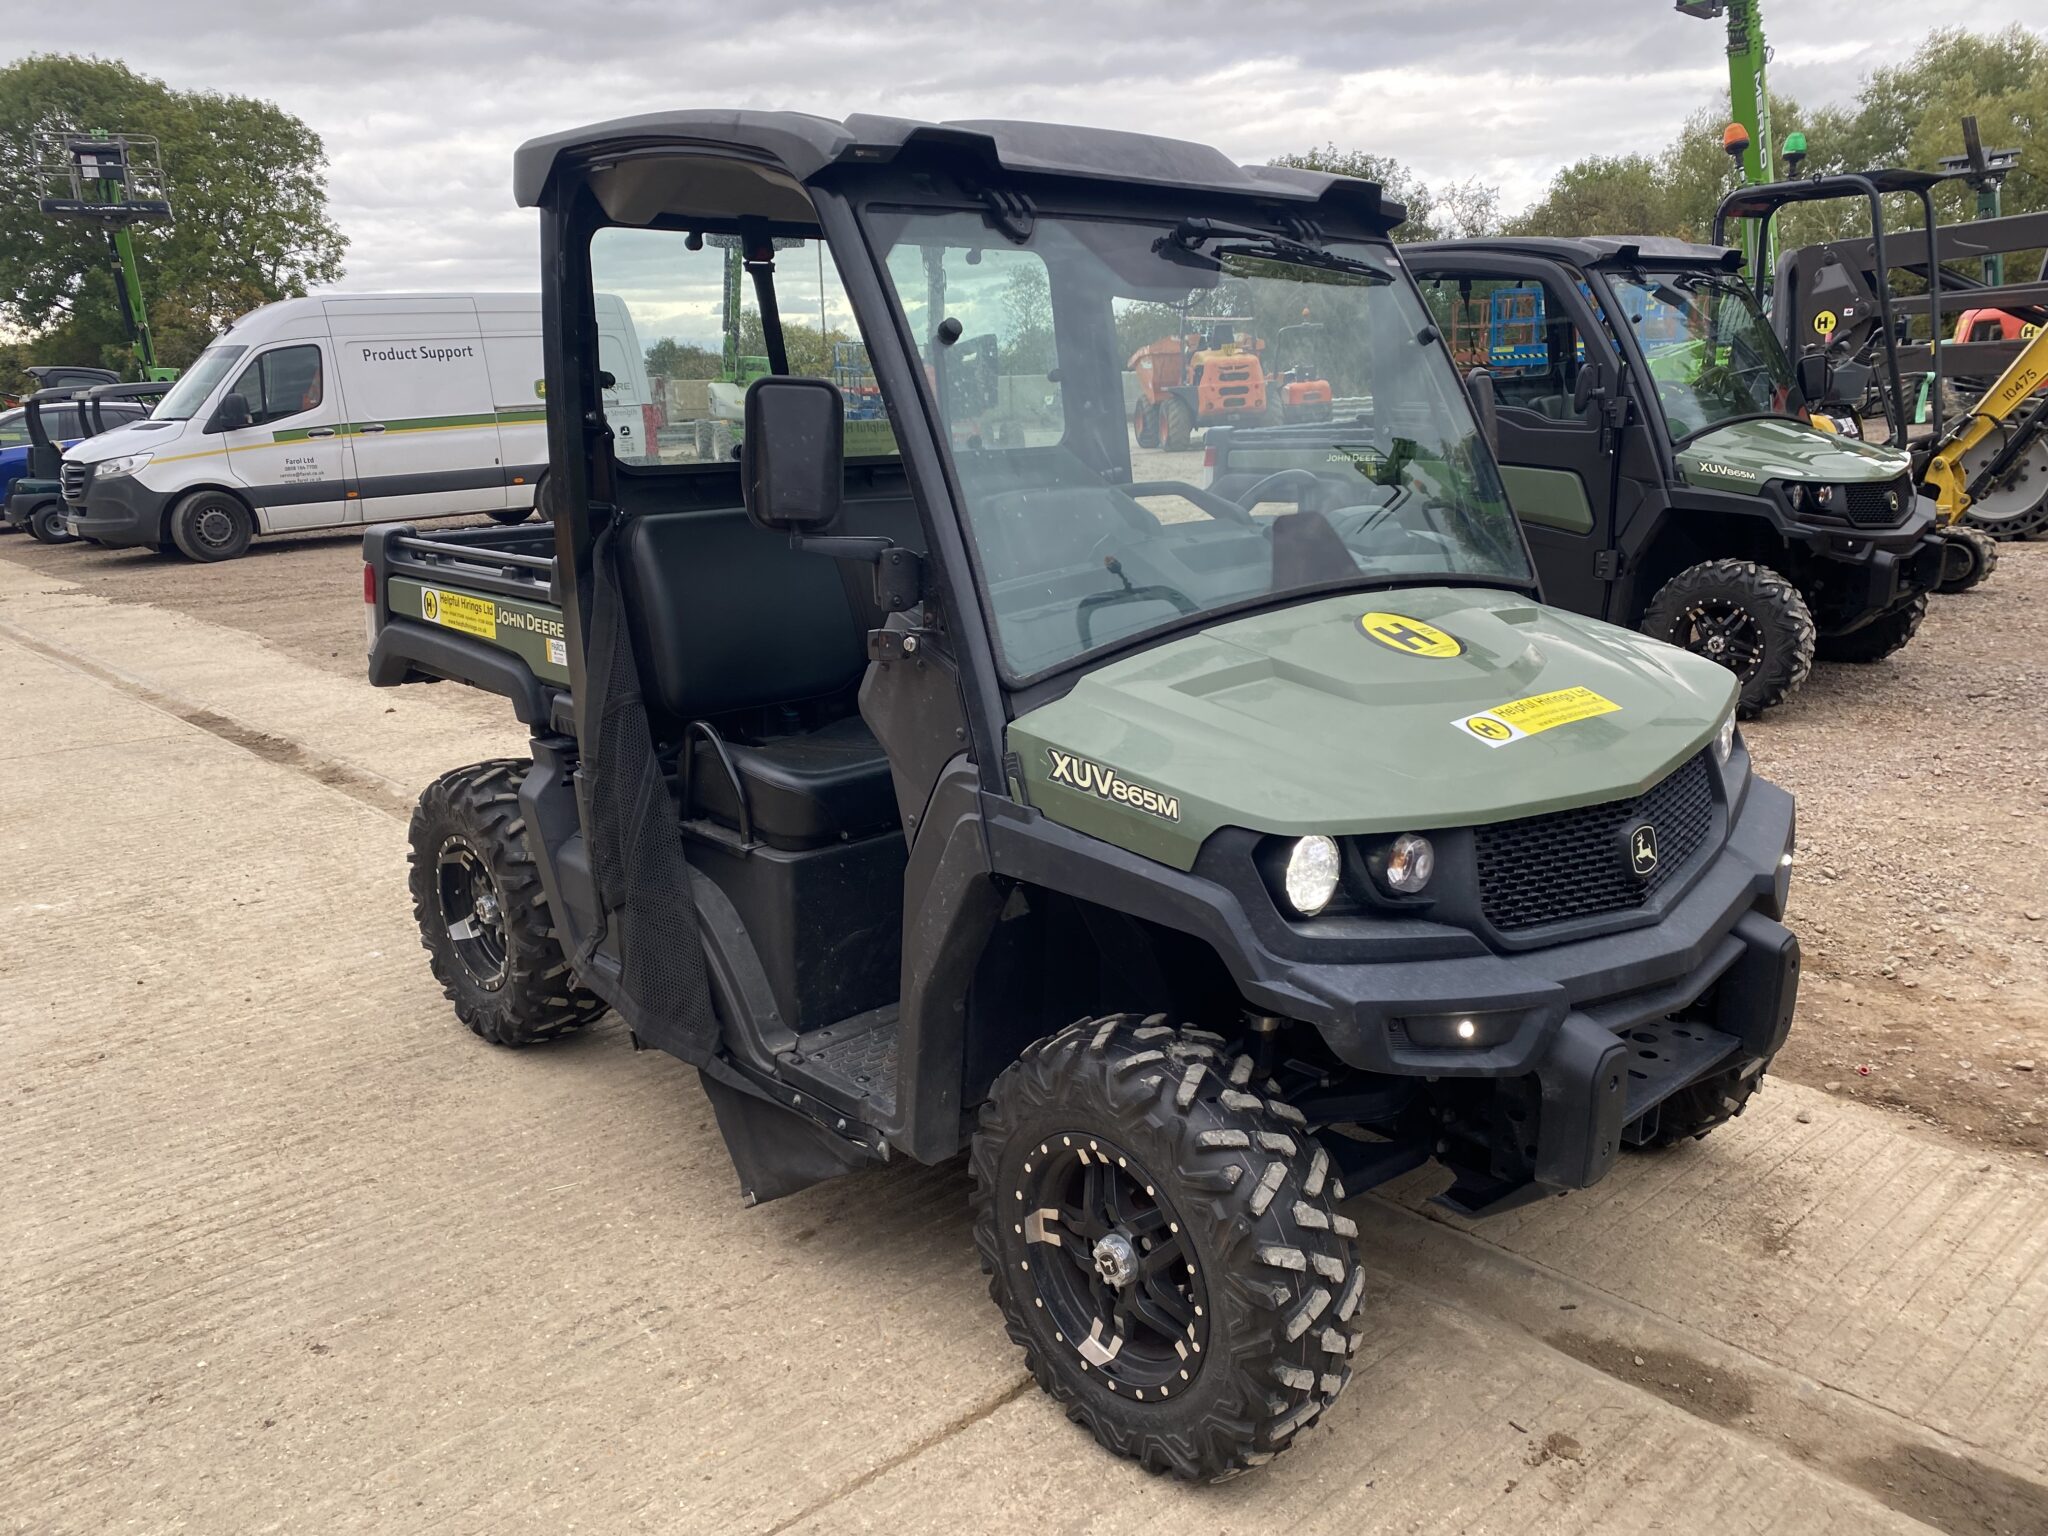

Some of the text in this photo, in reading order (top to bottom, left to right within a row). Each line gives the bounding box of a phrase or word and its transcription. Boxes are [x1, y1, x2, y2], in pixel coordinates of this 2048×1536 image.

[1754, 70, 1768, 169] MERLO
[1817, 316, 1829, 330] H
[362, 346, 474, 361] Product Support
[2002, 368, 2037, 401] 10475
[285, 457, 302, 465] Farol
[1326, 453, 1351, 463] JOHN
[1698, 461, 1756, 480] XUV865M
[439, 593, 494, 616] Helpful Hirings Ltd
[496, 607, 525, 629] JOHN
[526, 612, 565, 639] DEERE
[1373, 622, 1439, 651] H
[1493, 698, 1537, 719] Helpful
[1533, 690, 1576, 706] Hirings
[1571, 687, 1593, 698] Ltd
[1048, 748, 1179, 822] XUV865M
